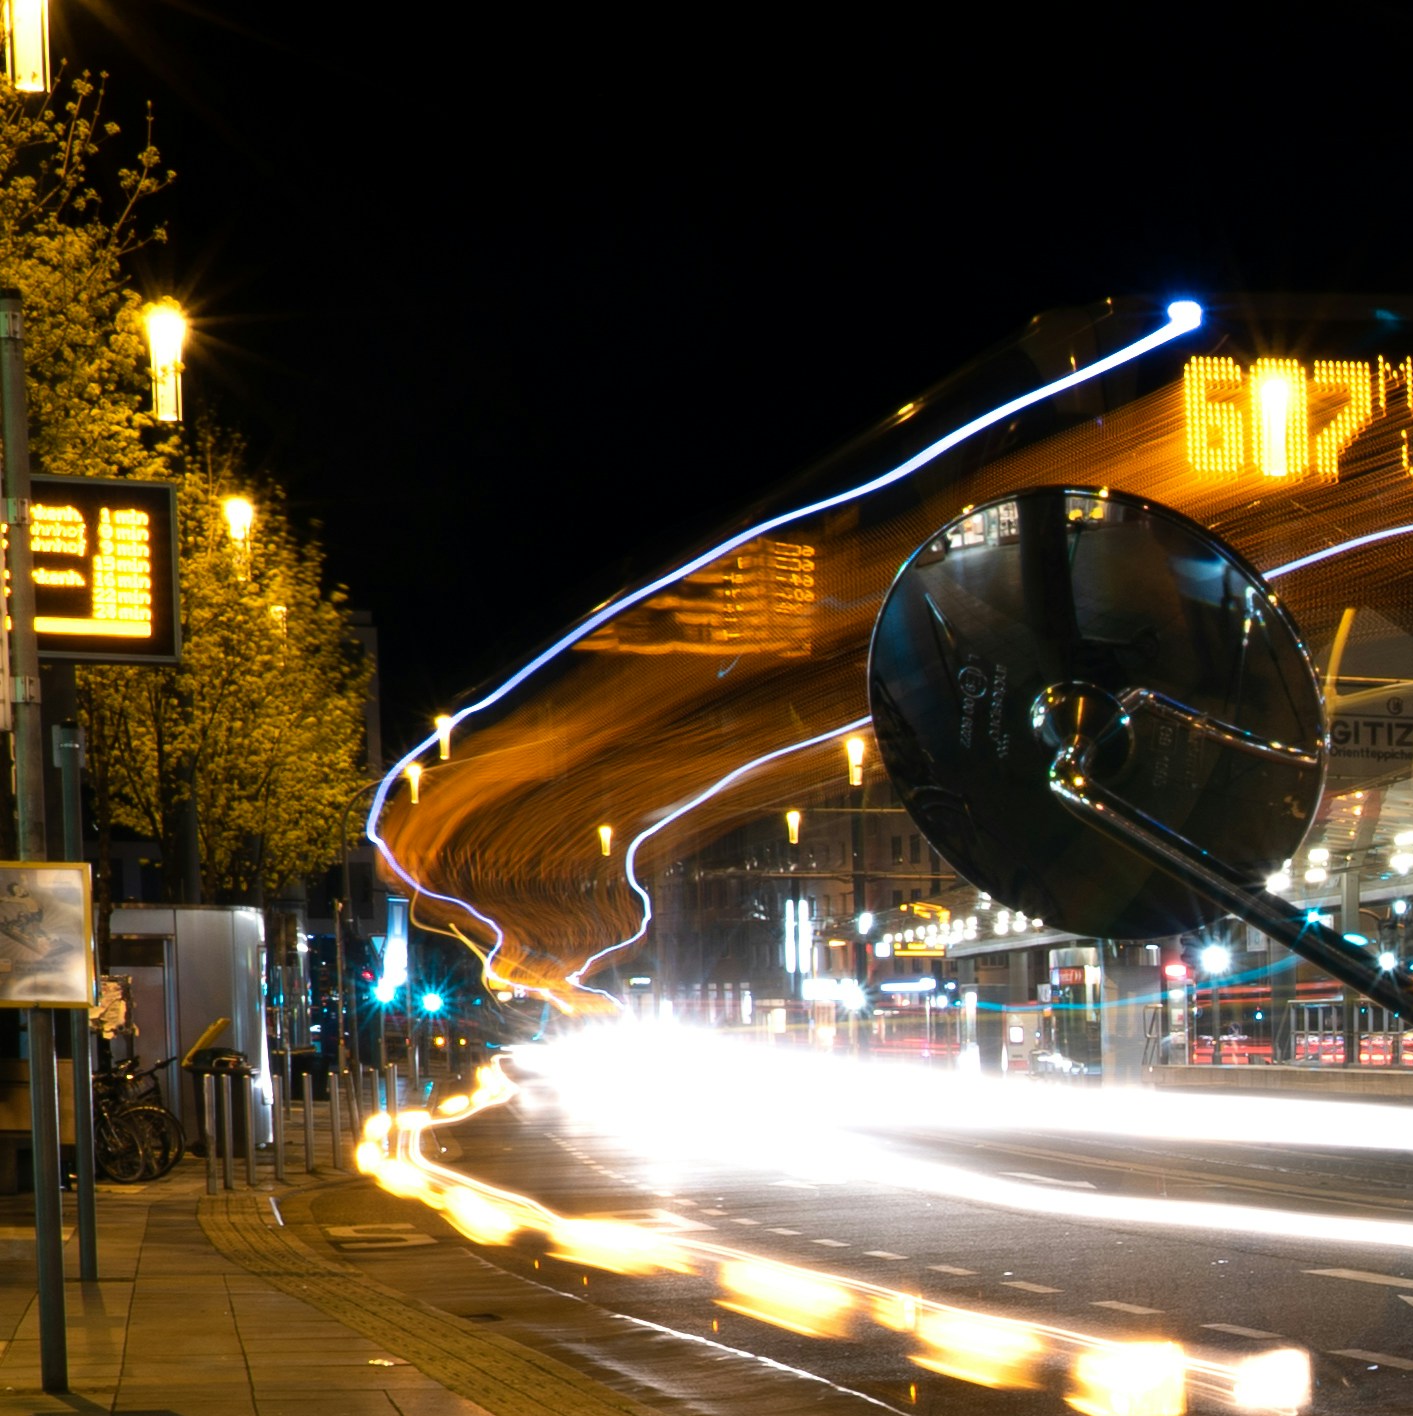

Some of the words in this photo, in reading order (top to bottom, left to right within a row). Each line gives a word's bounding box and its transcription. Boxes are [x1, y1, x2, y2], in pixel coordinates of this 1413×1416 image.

[1183, 354, 1374, 482] 607
[113, 508, 149, 526] min
[114, 525, 149, 541] min
[115, 541, 150, 557] min
[116, 557, 150, 573] min
[116, 573, 151, 589] min
[117, 589, 151, 605] min
[118, 605, 151, 621] min
